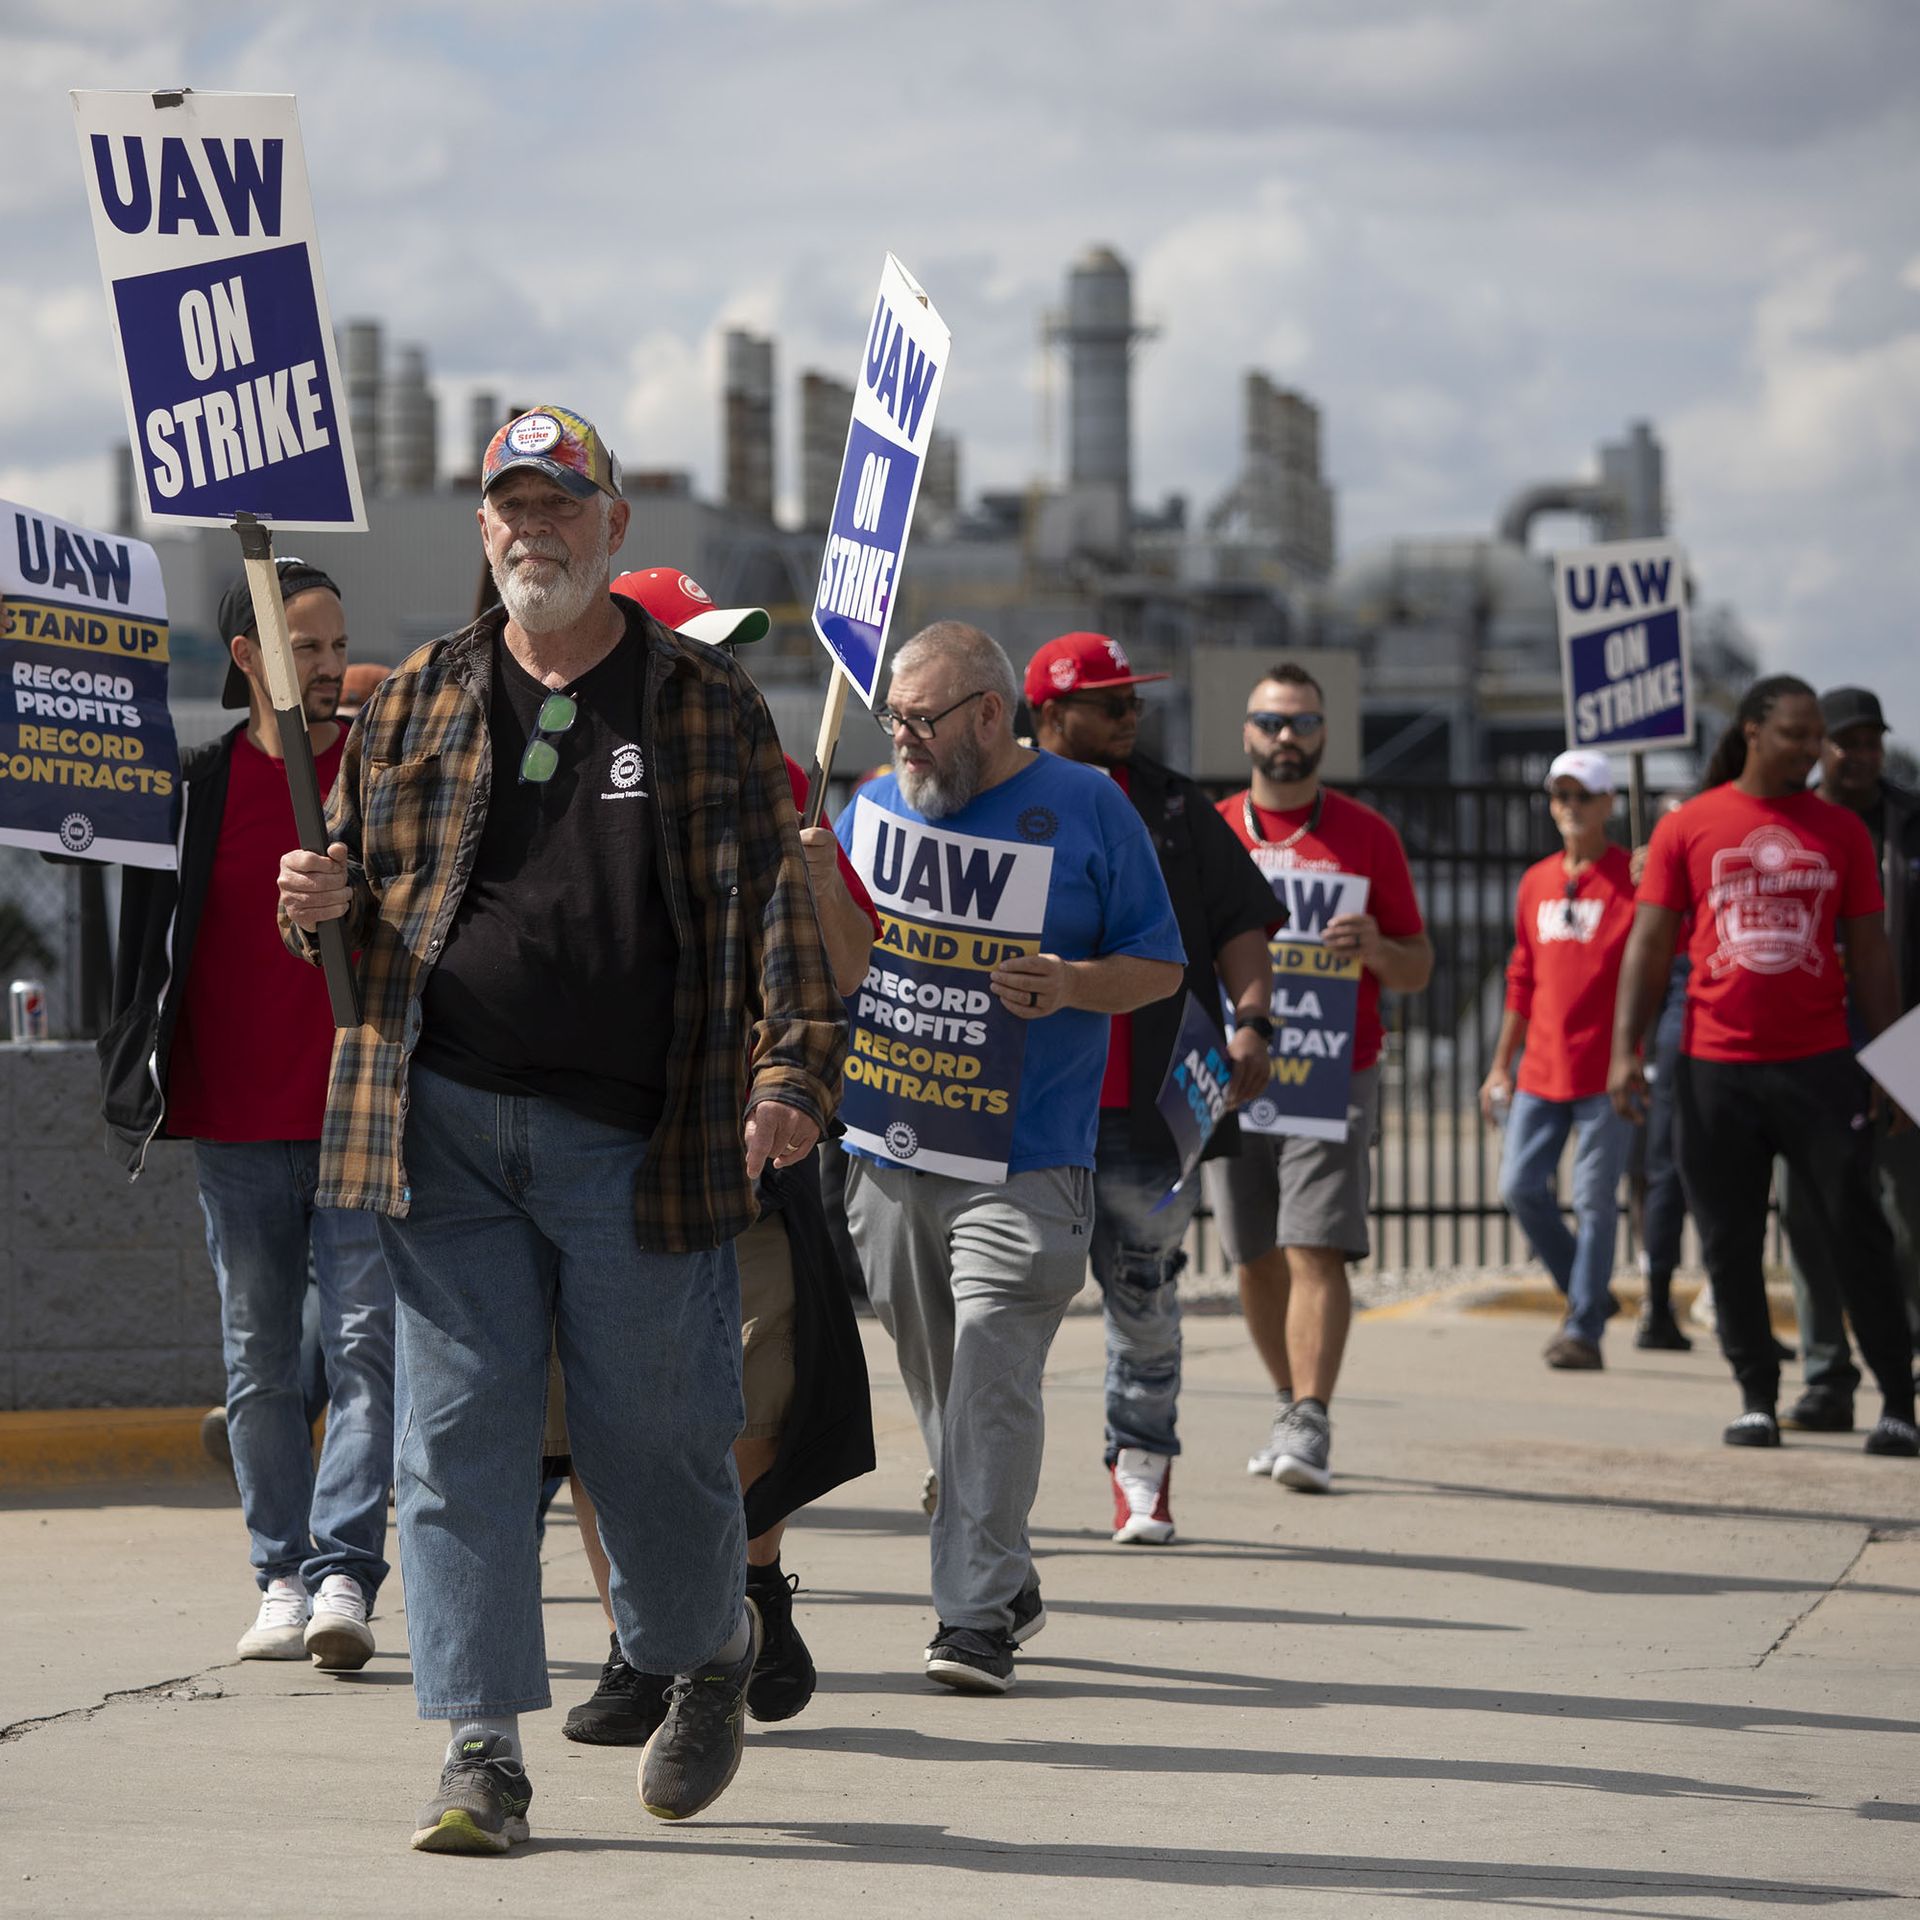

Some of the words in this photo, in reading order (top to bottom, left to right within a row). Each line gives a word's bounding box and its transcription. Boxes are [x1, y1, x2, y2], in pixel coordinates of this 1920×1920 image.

[90, 133, 284, 238] UAW
[178, 275, 256, 381] ON
[866, 295, 937, 443] UAW
[146, 359, 330, 499] STRIKE
[518, 432, 549, 441] Strike
[852, 452, 891, 533] ON
[15, 513, 131, 605] UAW
[819, 534, 895, 627] STRIKE
[1567, 558, 1672, 611] UAW
[5, 608, 108, 646] STAND
[119, 625, 159, 653] UP
[1604, 623, 1648, 681] ON
[12, 661, 134, 701] RECORD
[15, 689, 142, 728] PROFITS
[1577, 658, 1681, 741] STRIKE
[18, 724, 144, 761] RECORD
[873, 821, 1017, 921] UAW
[881, 920, 959, 961] AND
[862, 966, 991, 1015] RECORD
[857, 993, 987, 1046] PROFITS
[1279, 1027, 1348, 1059] PAY
[854, 1028, 981, 1079] RECORD
[844, 1055, 1009, 1114] ONTRACTS
